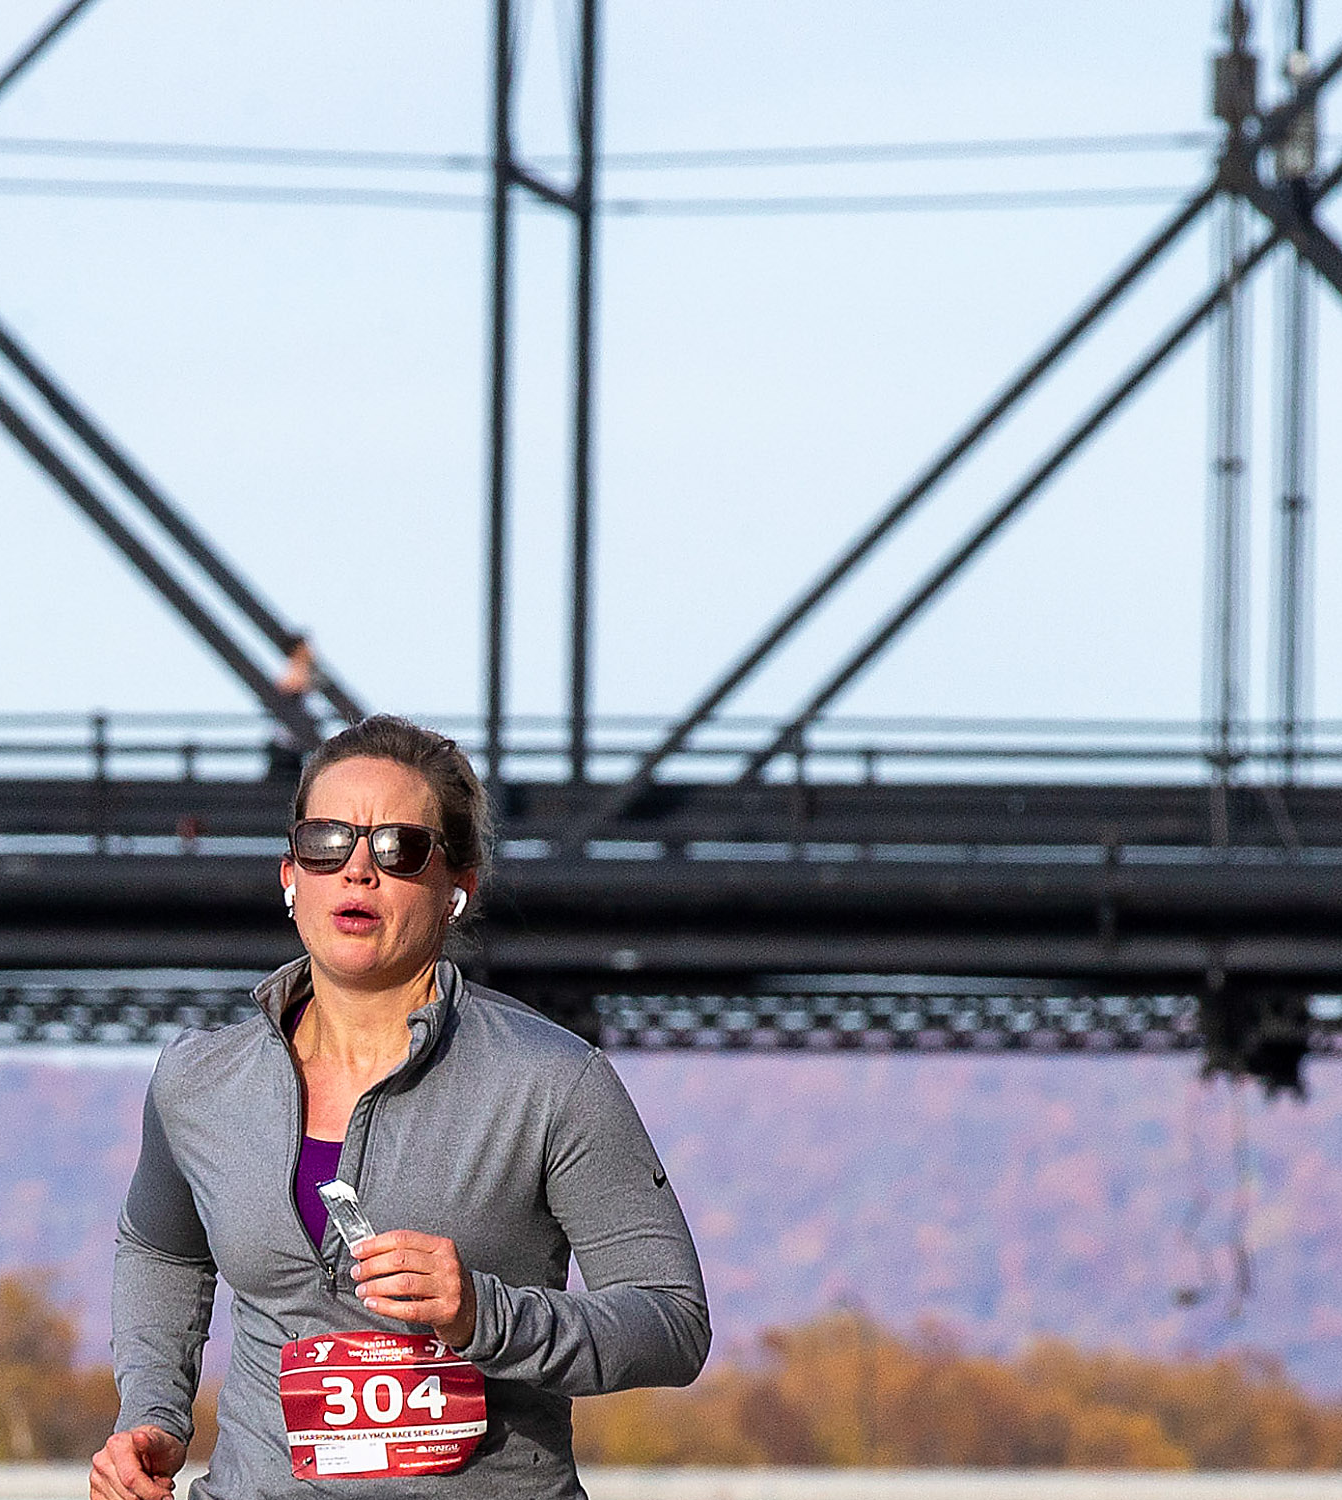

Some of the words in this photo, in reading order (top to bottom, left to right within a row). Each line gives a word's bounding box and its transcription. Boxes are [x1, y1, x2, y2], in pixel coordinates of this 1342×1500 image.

[321, 1375, 447, 1426] 304
[299, 1433, 346, 1441] HARRISBURG
[347, 1433, 368, 1441] AREA
[392, 1430, 411, 1438] RACE
[413, 1428, 440, 1437] SERIES
